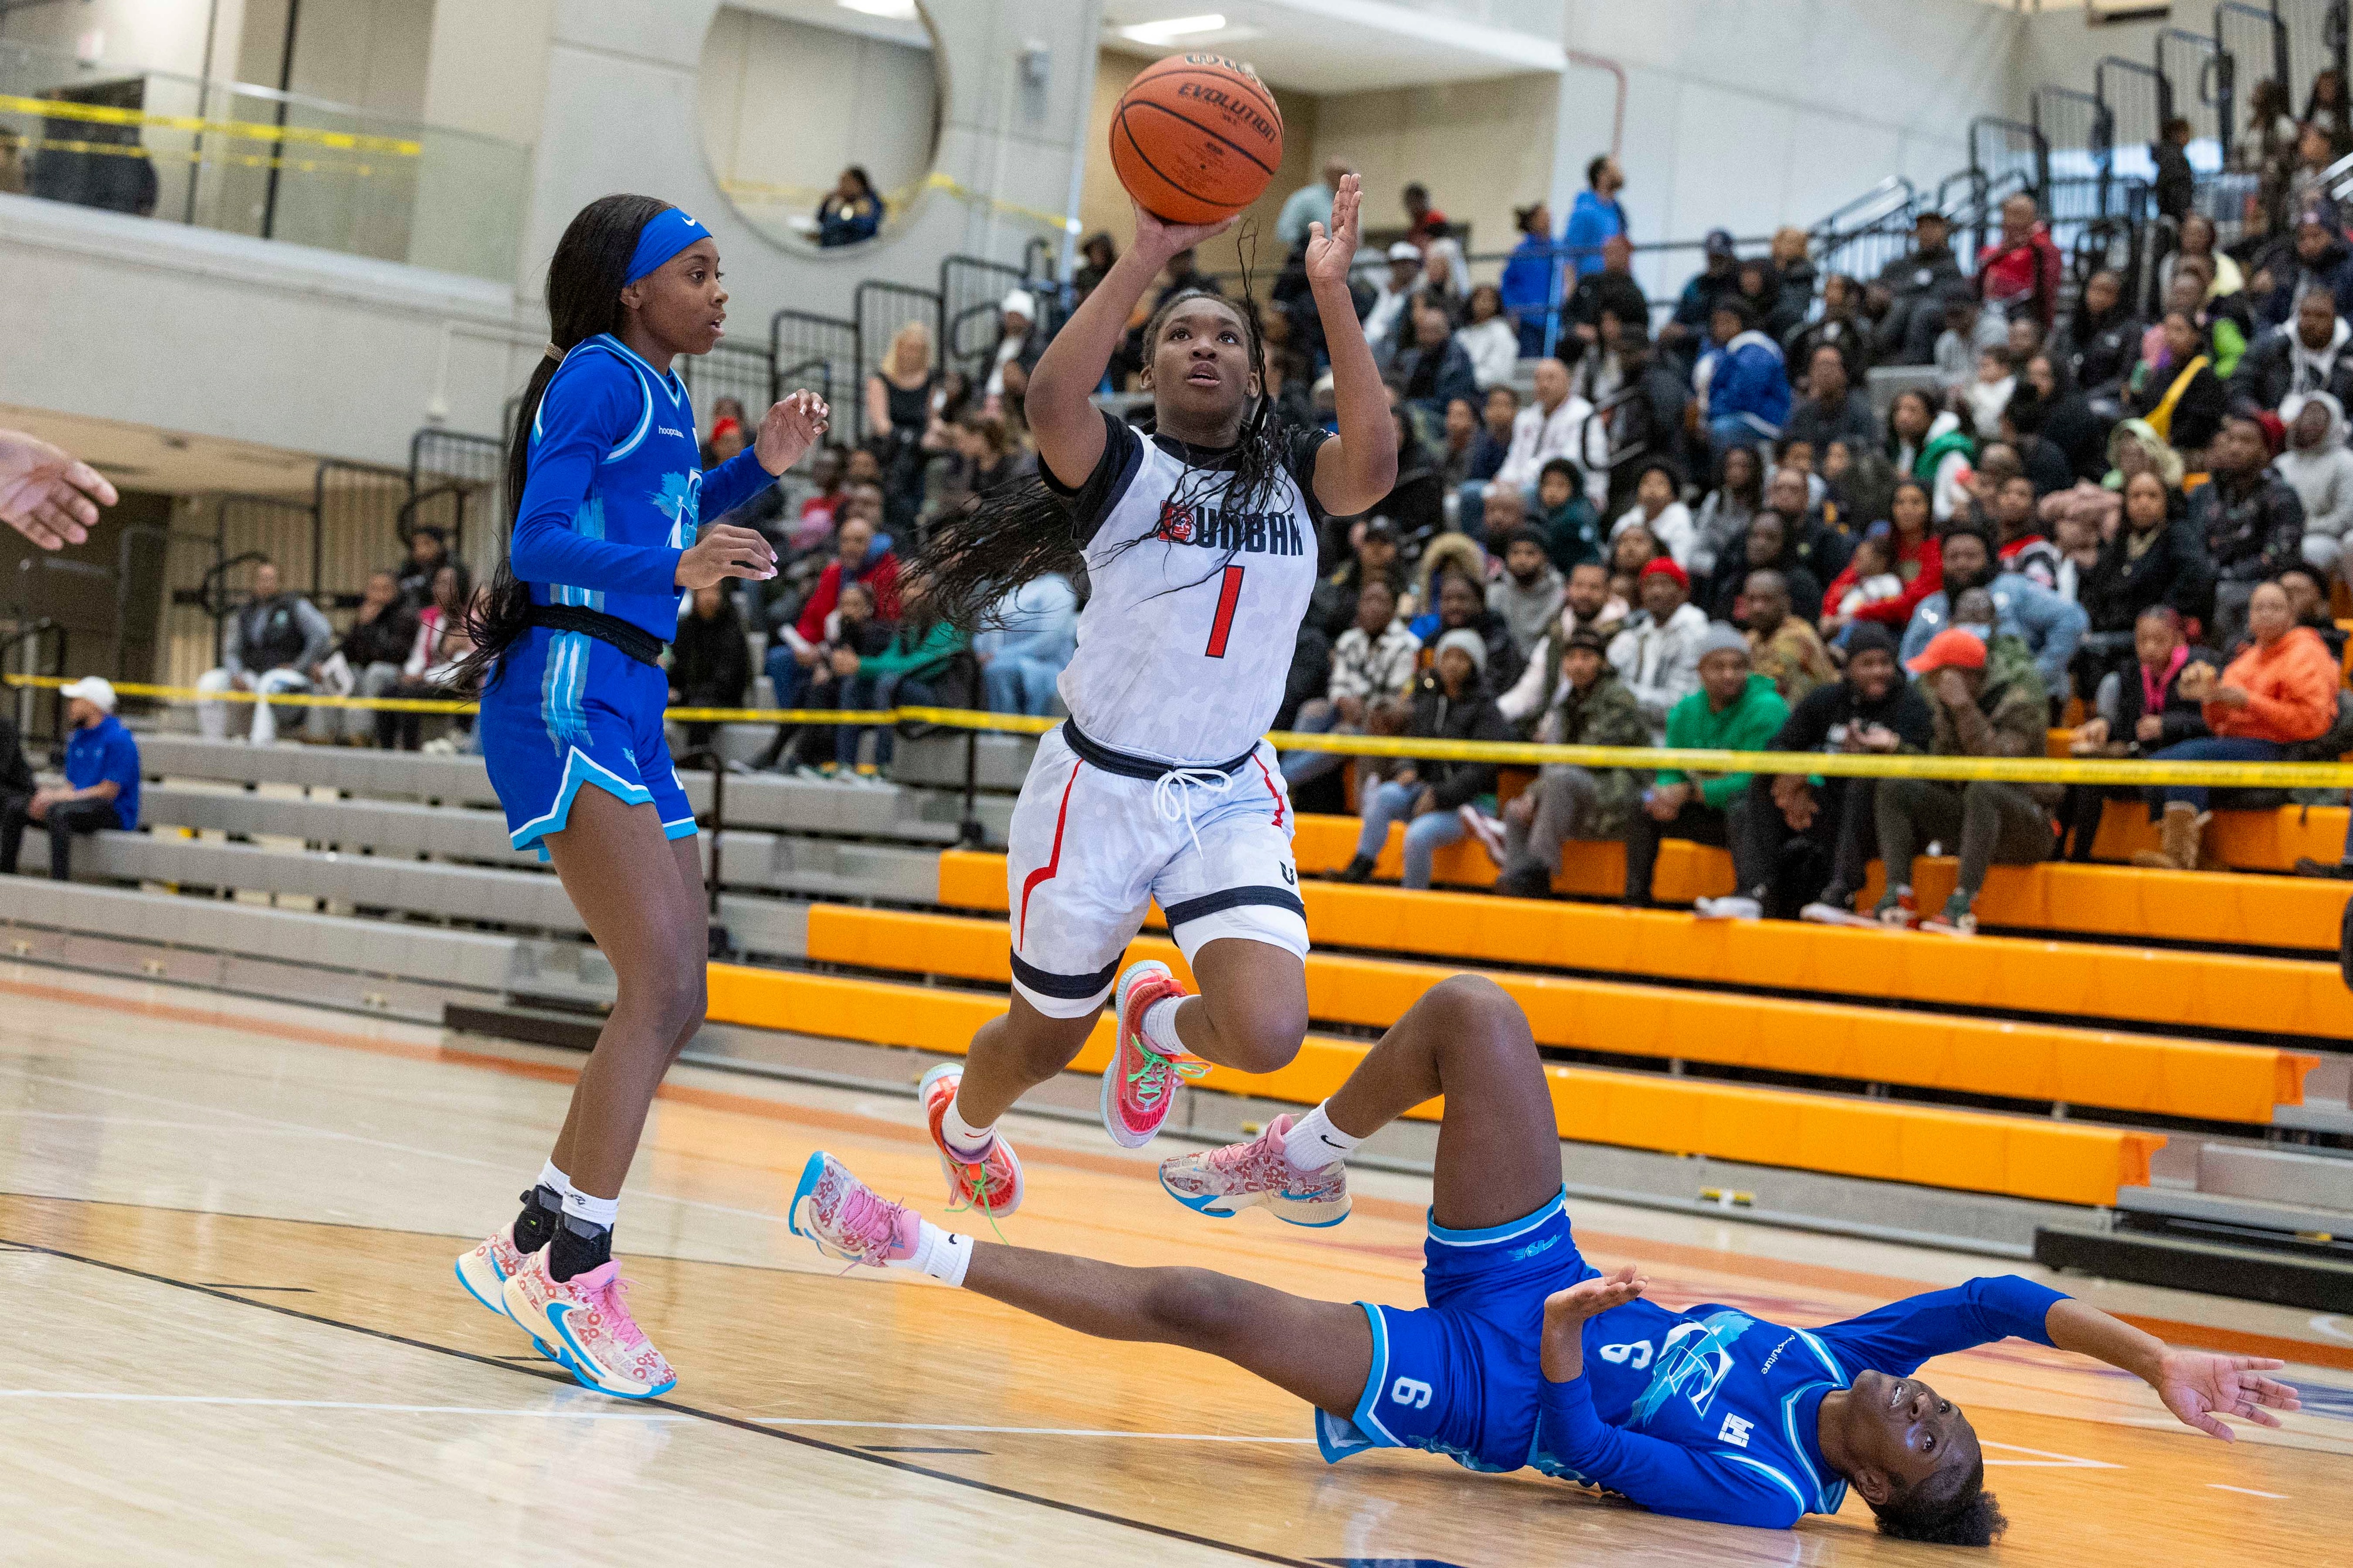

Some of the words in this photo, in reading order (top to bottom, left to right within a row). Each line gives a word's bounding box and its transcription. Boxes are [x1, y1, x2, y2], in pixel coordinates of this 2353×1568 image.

[1178, 82, 1277, 144] EVOLUTION
[658, 425, 684, 439] hoopcule
[1204, 565, 1245, 659] 1
[1761, 1334, 1796, 1374] pculture
[1391, 1376, 1433, 1409] 6
